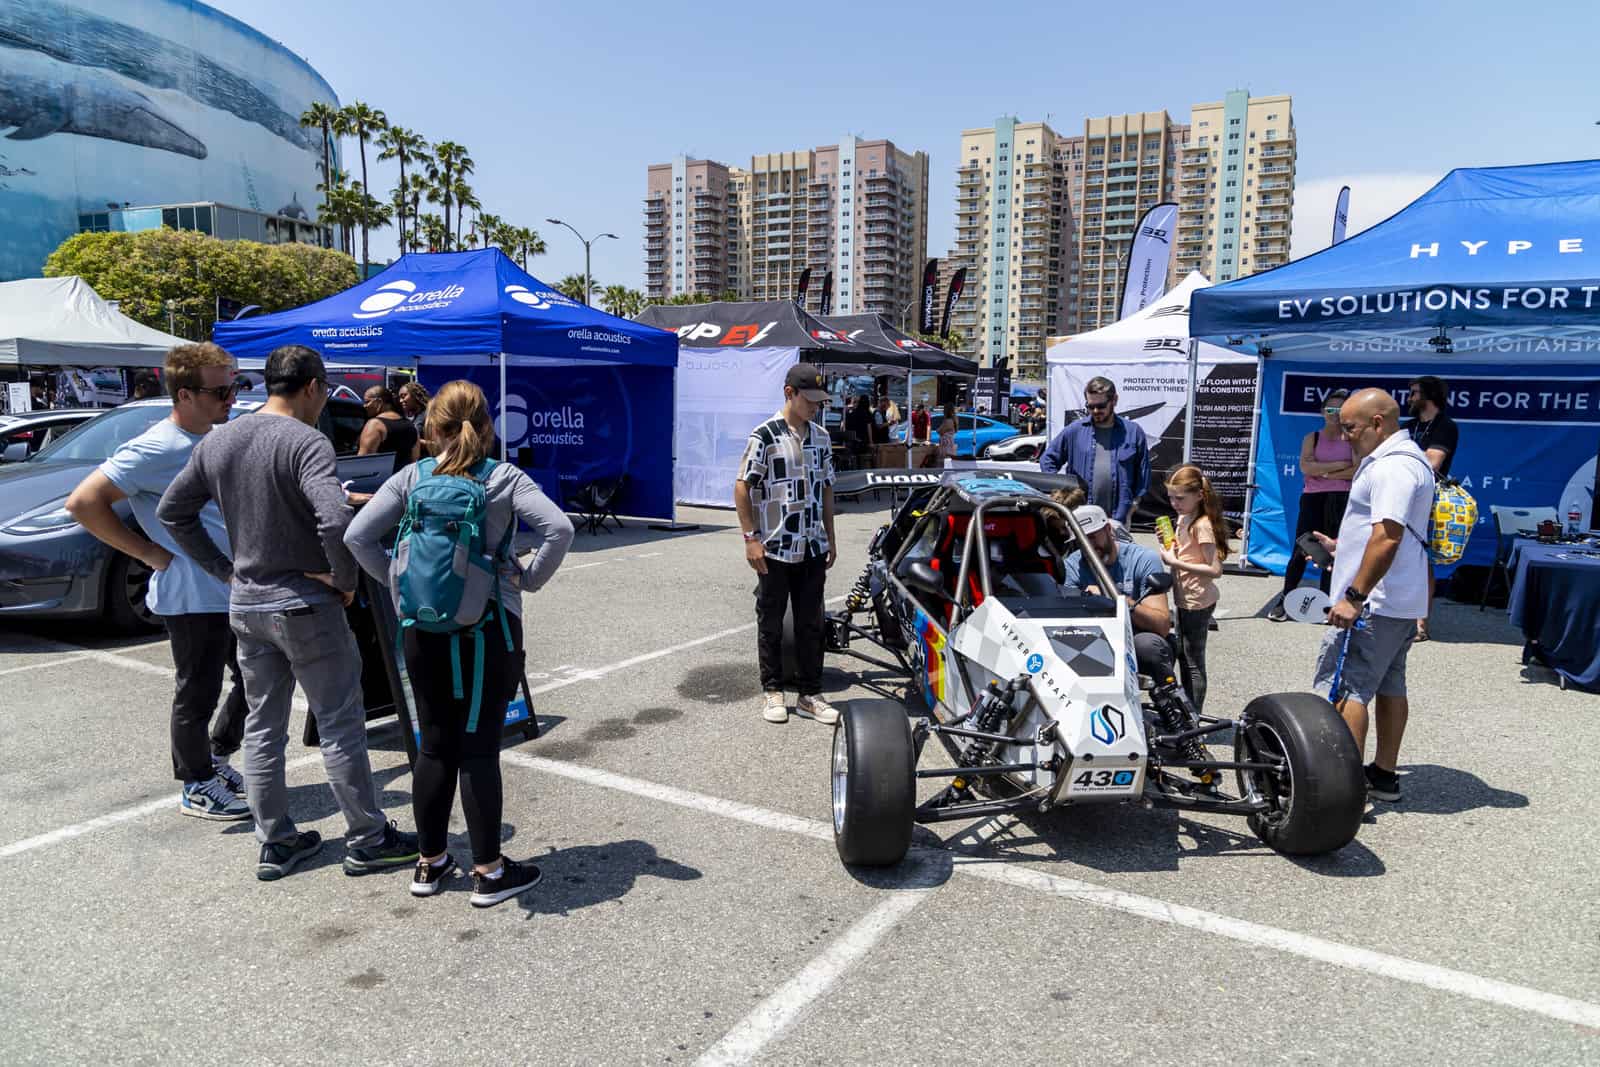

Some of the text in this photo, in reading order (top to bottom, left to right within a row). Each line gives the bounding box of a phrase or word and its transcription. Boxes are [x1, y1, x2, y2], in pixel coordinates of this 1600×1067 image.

[1409, 238, 1584, 259] HYPE
[408, 283, 465, 303] orella
[1278, 299, 1313, 318] EV
[1320, 288, 1491, 316] SOLUTIONS
[1501, 287, 1570, 310] FOR
[339, 325, 383, 337] acoustics
[567, 328, 632, 344] orella acoustics
[1303, 386, 1331, 402] EV
[1479, 391, 1531, 409] FOR
[1539, 392, 1589, 410] THE
[531, 406, 585, 429] orella
[531, 431, 584, 445] acoustics
[1001, 622, 1030, 657] HYPER
[1040, 671, 1073, 709] CRAFT
